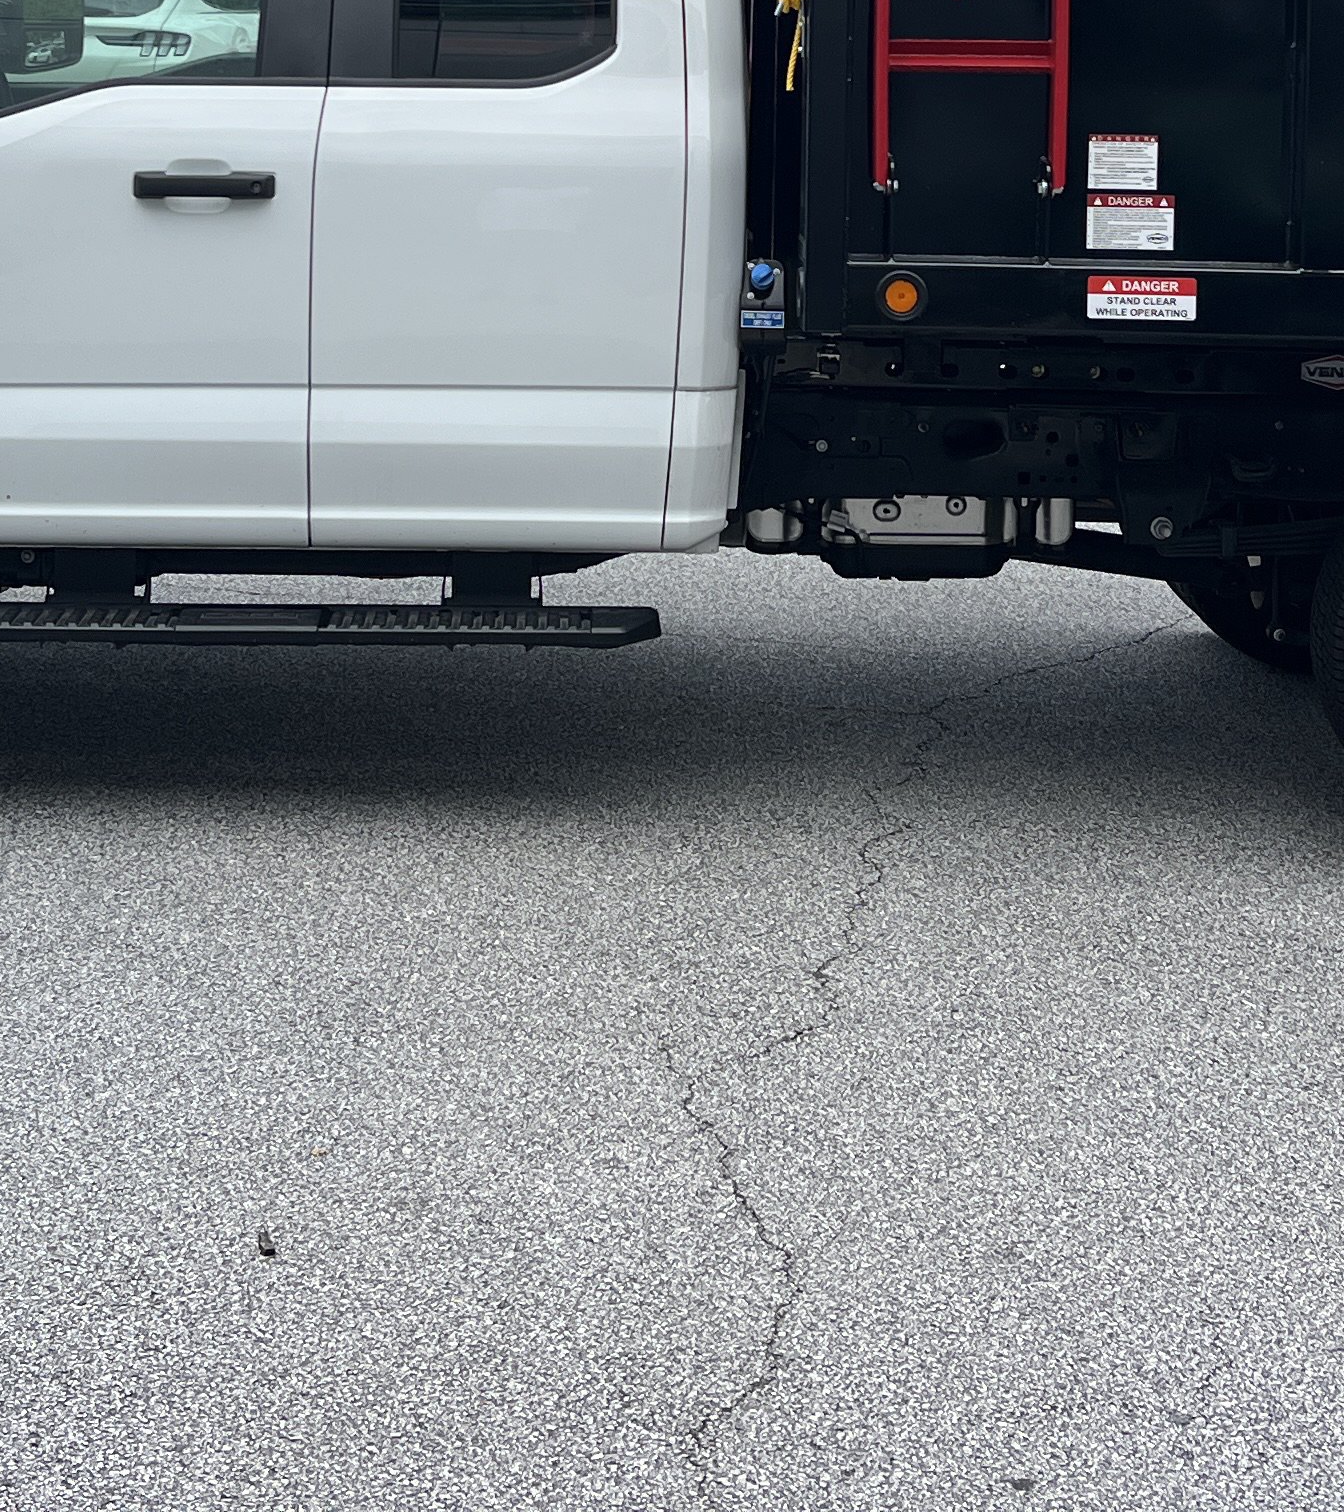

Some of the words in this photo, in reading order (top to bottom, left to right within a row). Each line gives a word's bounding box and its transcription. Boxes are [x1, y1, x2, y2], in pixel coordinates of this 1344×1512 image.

[1108, 196, 1153, 207] DANGER
[1122, 280, 1179, 292] DANGER
[1107, 297, 1140, 305] STAND
[1143, 297, 1176, 306] CLEAR
[1096, 308, 1127, 317] WHILE
[1130, 309, 1188, 317] OPERATING
